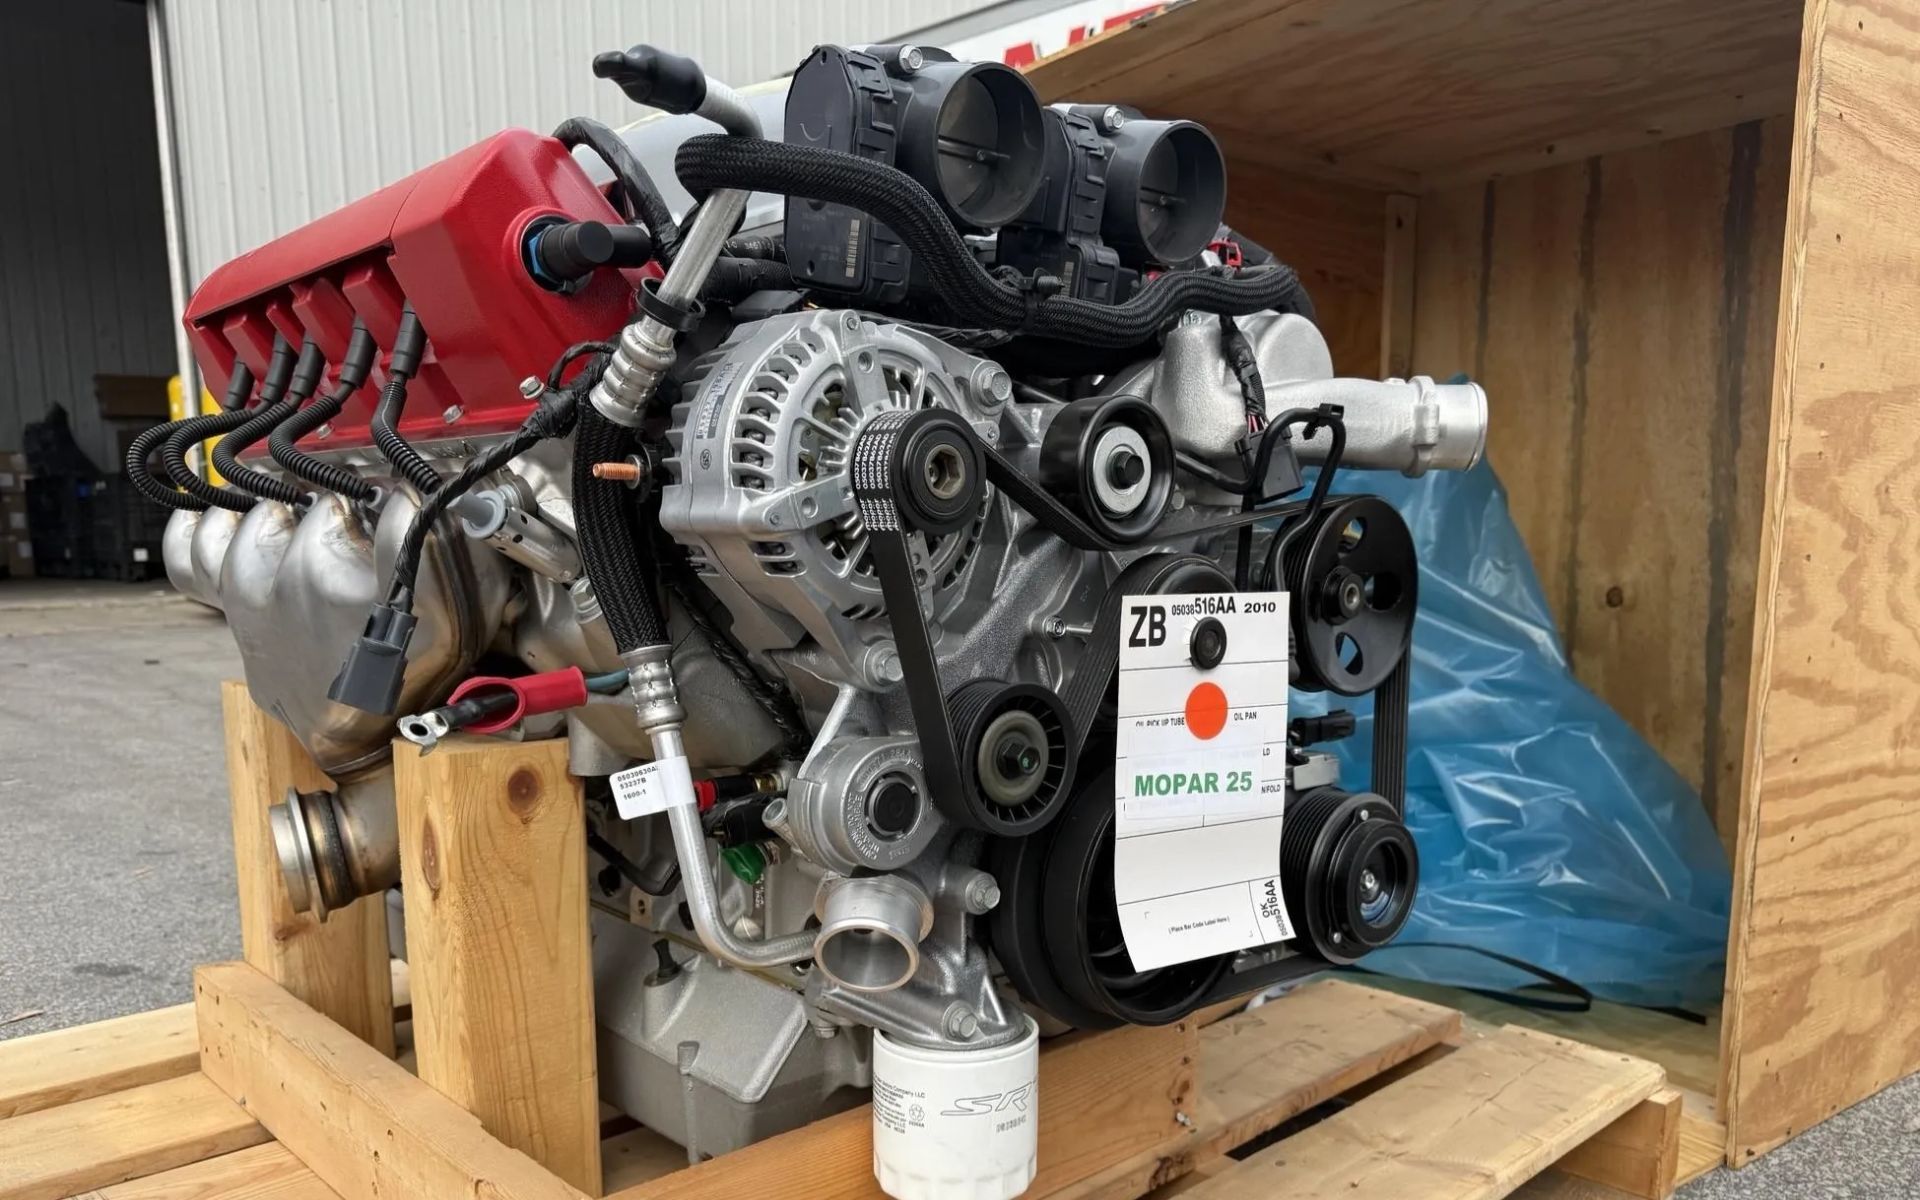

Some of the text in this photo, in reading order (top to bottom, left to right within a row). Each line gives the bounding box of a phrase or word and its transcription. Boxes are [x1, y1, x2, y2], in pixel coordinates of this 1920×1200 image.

[1128, 596, 1276, 648] ZB 05038516AA 2010
[1170, 716, 1184, 726] TUBE
[1234, 711, 1257, 721] OIL PAN
[1135, 772, 1252, 797] MOPAR 25
[1260, 902, 1270, 918] OK
[1264, 879, 1288, 936] 05038516AA
